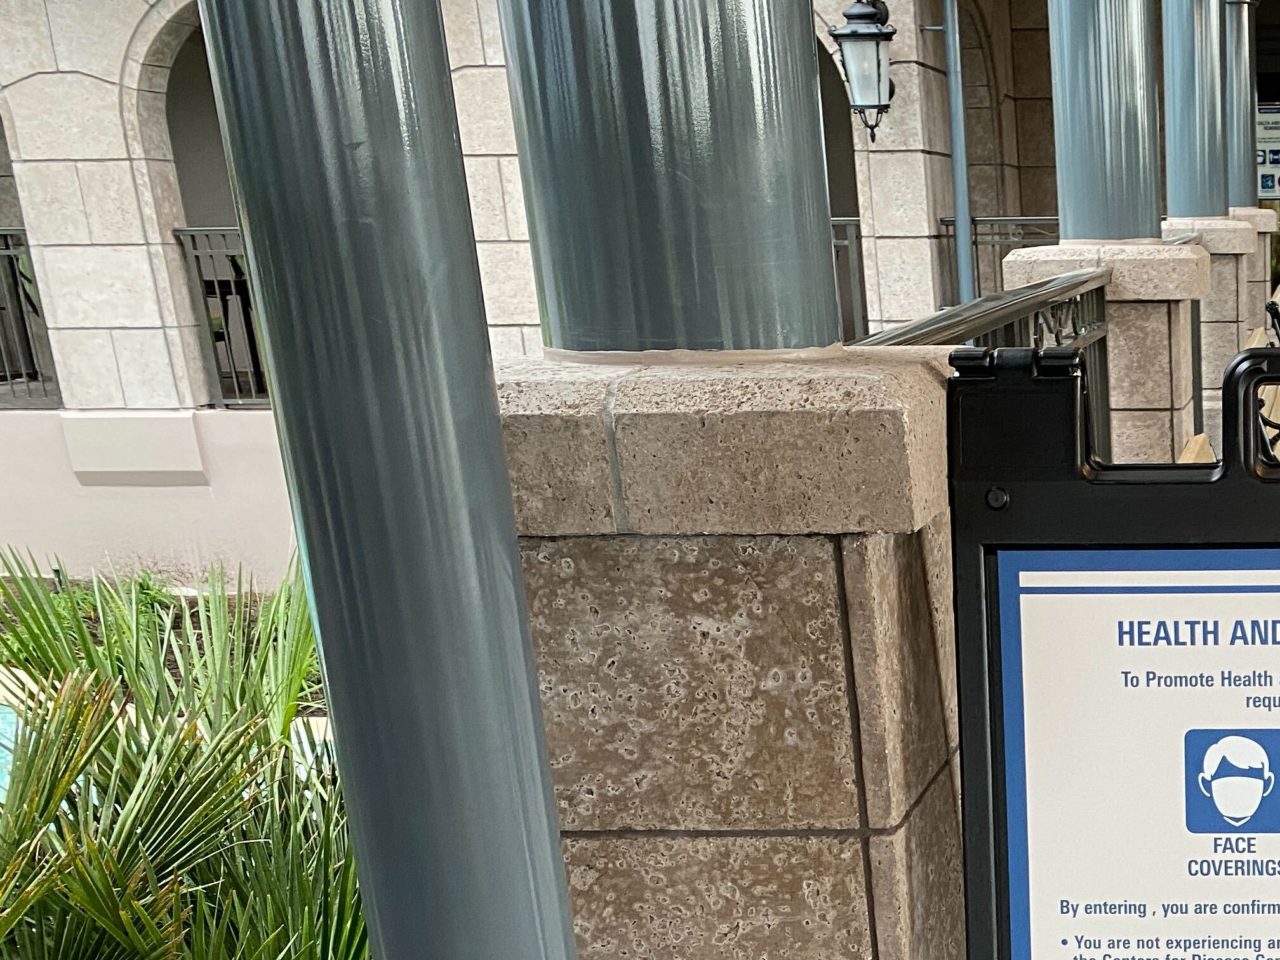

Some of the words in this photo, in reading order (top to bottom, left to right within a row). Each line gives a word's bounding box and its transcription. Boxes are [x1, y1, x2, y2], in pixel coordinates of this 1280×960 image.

[1118, 620, 1219, 646] HEALTH
[1121, 671, 1140, 688] To
[1146, 671, 1214, 688] Promote
[1221, 670, 1273, 687] Health
[1213, 836, 1257, 854] FACE
[1060, 899, 1079, 918] By
[1084, 900, 1147, 918] entering
[1161, 903, 1189, 918] you
[1194, 903, 1218, 915] are
[1074, 935, 1101, 949] You
[1107, 939, 1131, 950] are
[1137, 937, 1160, 949] not
[1166, 935, 1261, 953] experiencing
